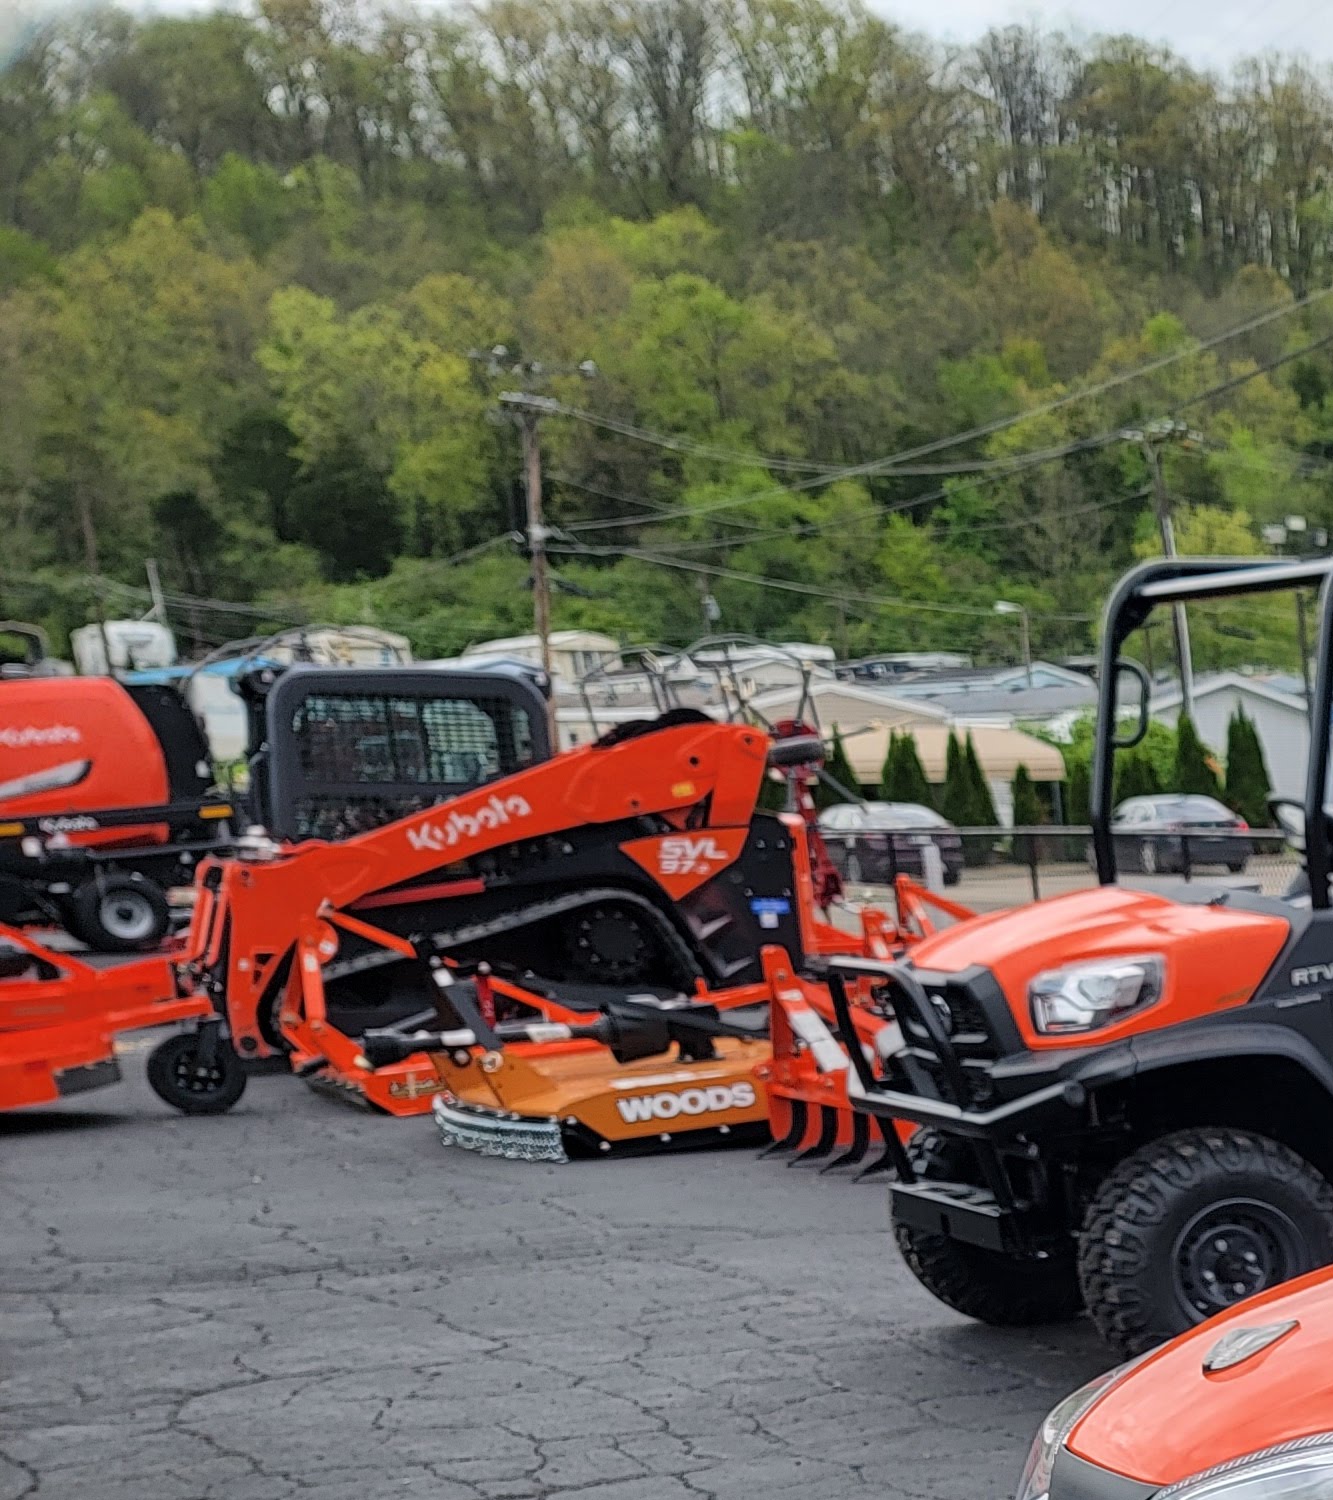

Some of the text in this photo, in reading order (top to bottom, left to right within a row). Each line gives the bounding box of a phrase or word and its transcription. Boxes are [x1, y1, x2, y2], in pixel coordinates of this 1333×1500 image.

[405, 795, 533, 852] Kubota
[659, 838, 728, 860] SVL
[616, 1081, 756, 1124] WOODS
